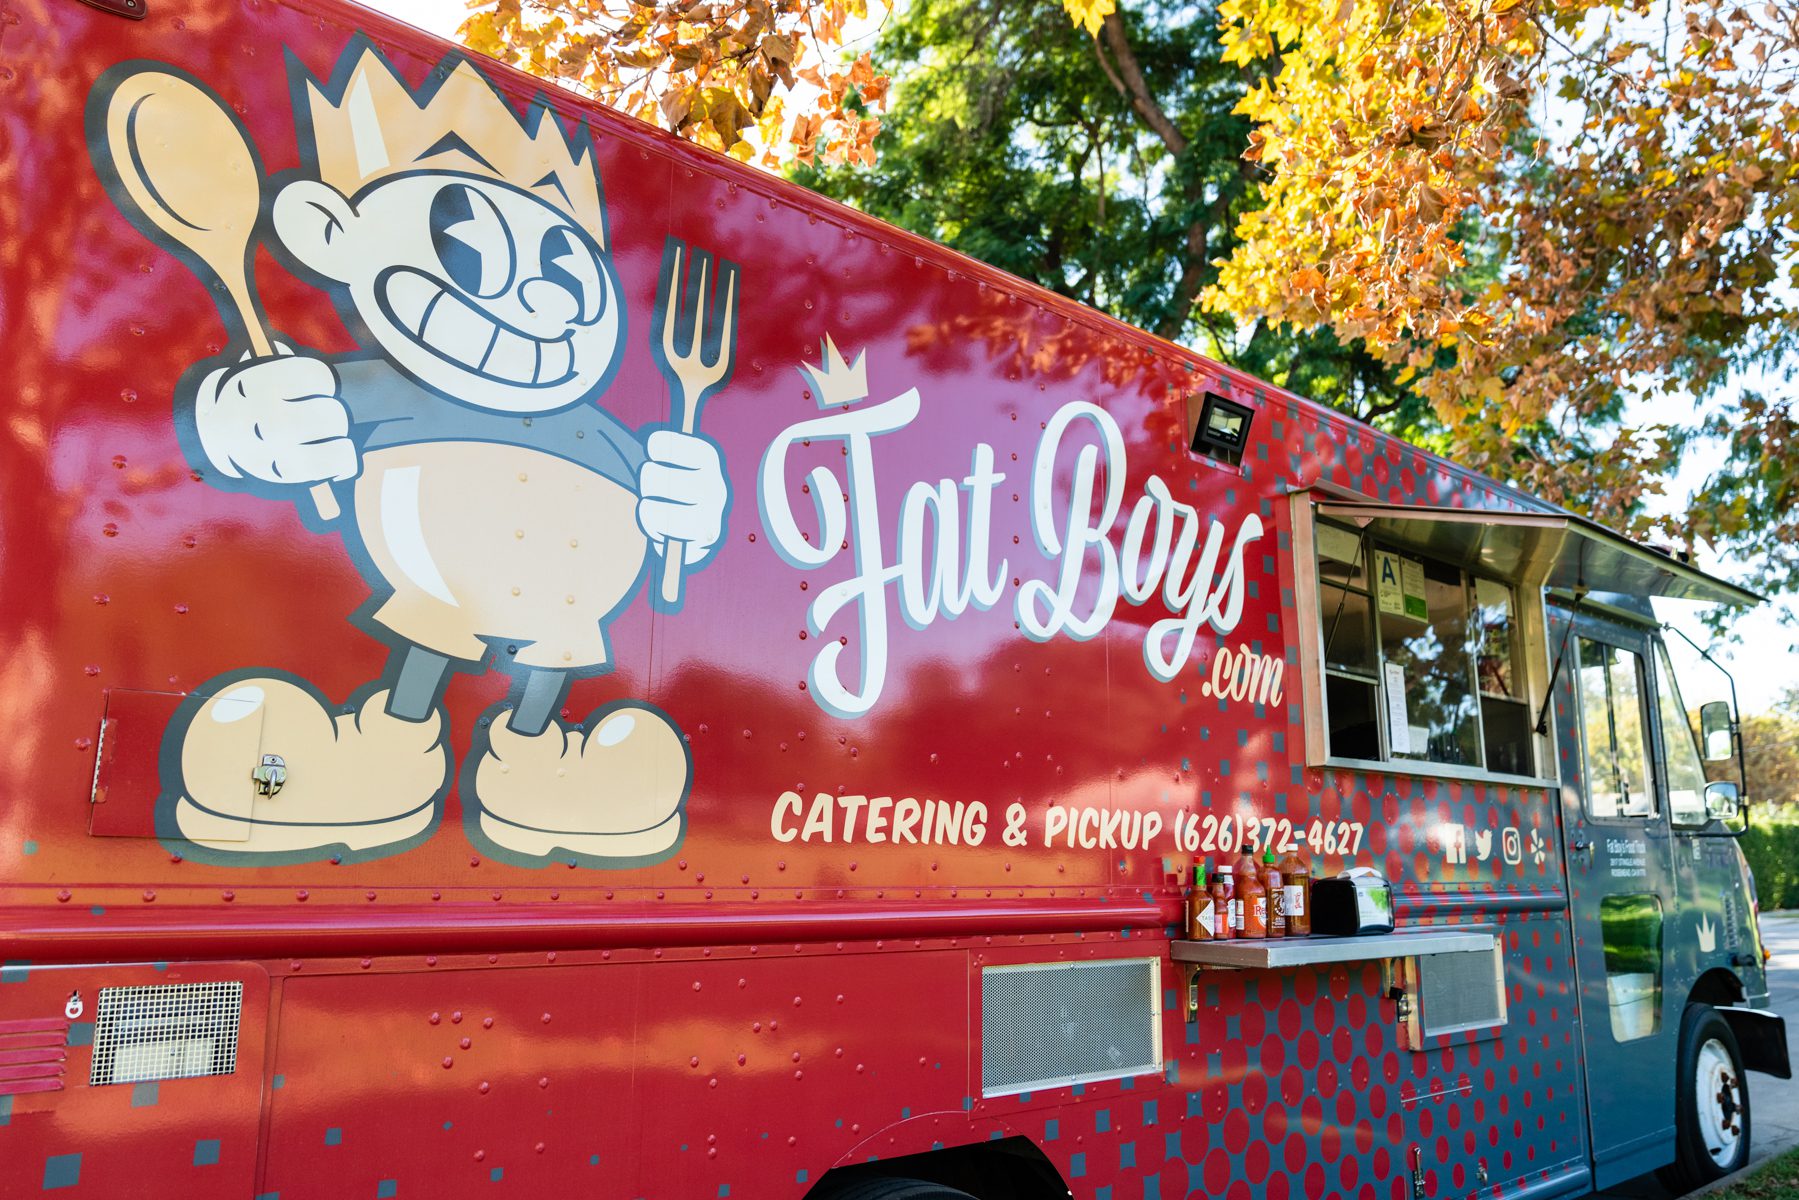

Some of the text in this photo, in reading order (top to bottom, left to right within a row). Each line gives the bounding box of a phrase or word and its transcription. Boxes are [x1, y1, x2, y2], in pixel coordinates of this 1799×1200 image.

[757, 386, 1264, 718] Fat Boys
[1382, 556, 1396, 585] A
[1202, 643, 1284, 708] .com
[771, 791, 988, 847] CATERING
[1002, 803, 1028, 847] &
[1044, 805, 1164, 852] PICKUP
